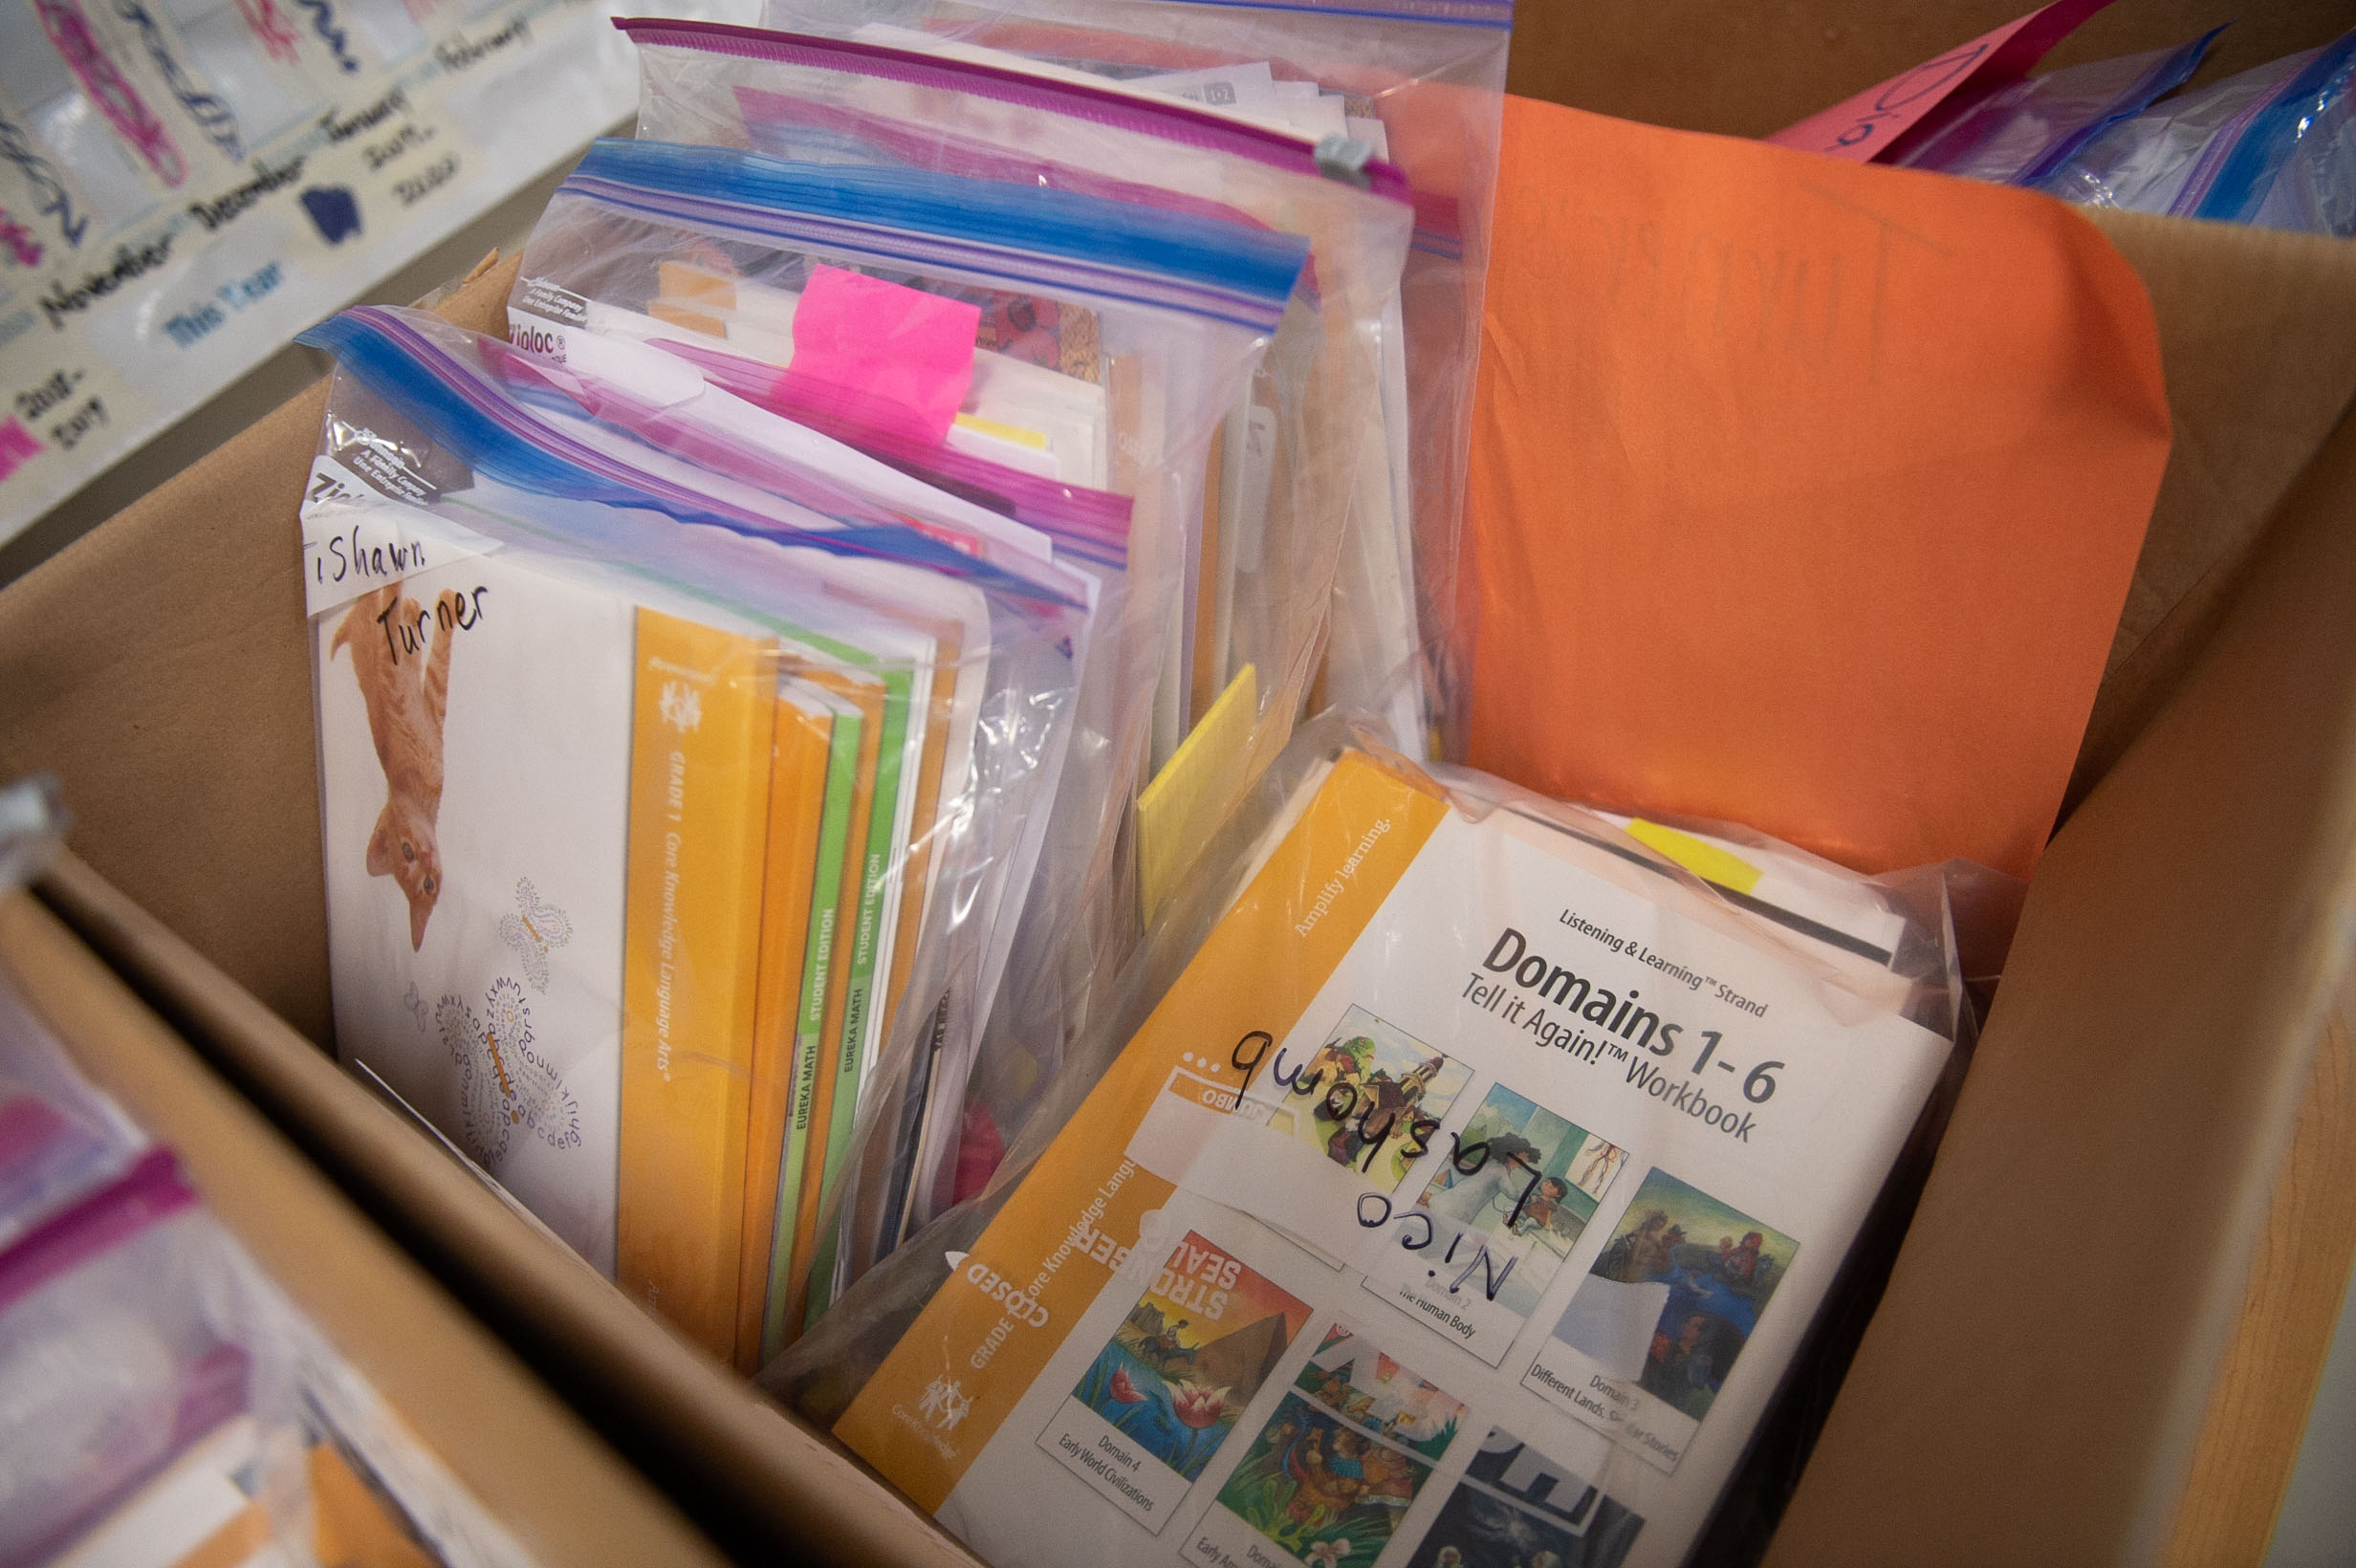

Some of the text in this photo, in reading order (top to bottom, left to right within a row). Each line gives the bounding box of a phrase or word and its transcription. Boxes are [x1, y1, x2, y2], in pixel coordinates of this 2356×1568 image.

[377, 585, 490, 666] Turner
[1295, 818, 1390, 937] Amplify learning.
[656, 962, 675, 1038] Language
[844, 854, 881, 1073] EUREKA MATH STUDENT EDITION
[1482, 926, 1684, 1056] Domains
[1559, 909, 1625, 952] Listening
[1625, 942, 1639, 957] &
[1714, 983, 1770, 1018] Strand
[796, 908, 835, 1130] EUREKA MATH STUDENT EDITION
[1461, 972, 1508, 1013] Tell
[1501, 995, 1526, 1024] it
[1625, 1055, 1758, 1144] Workbook
[1170, 1241, 1242, 1291] SEAL
[1357, 1191, 1519, 1301] Nico
[967, 1263, 1049, 1328] CLOSED
[1450, 1315, 1476, 1339] Body
[971, 1318, 1014, 1370] GRADE
[1530, 1363, 1576, 1399] Different
[1058, 1432, 1156, 1513] Early World Civilizations
[1098, 1433, 1143, 1473] Domain 4
[1196, 1536, 1222, 1563] Early
